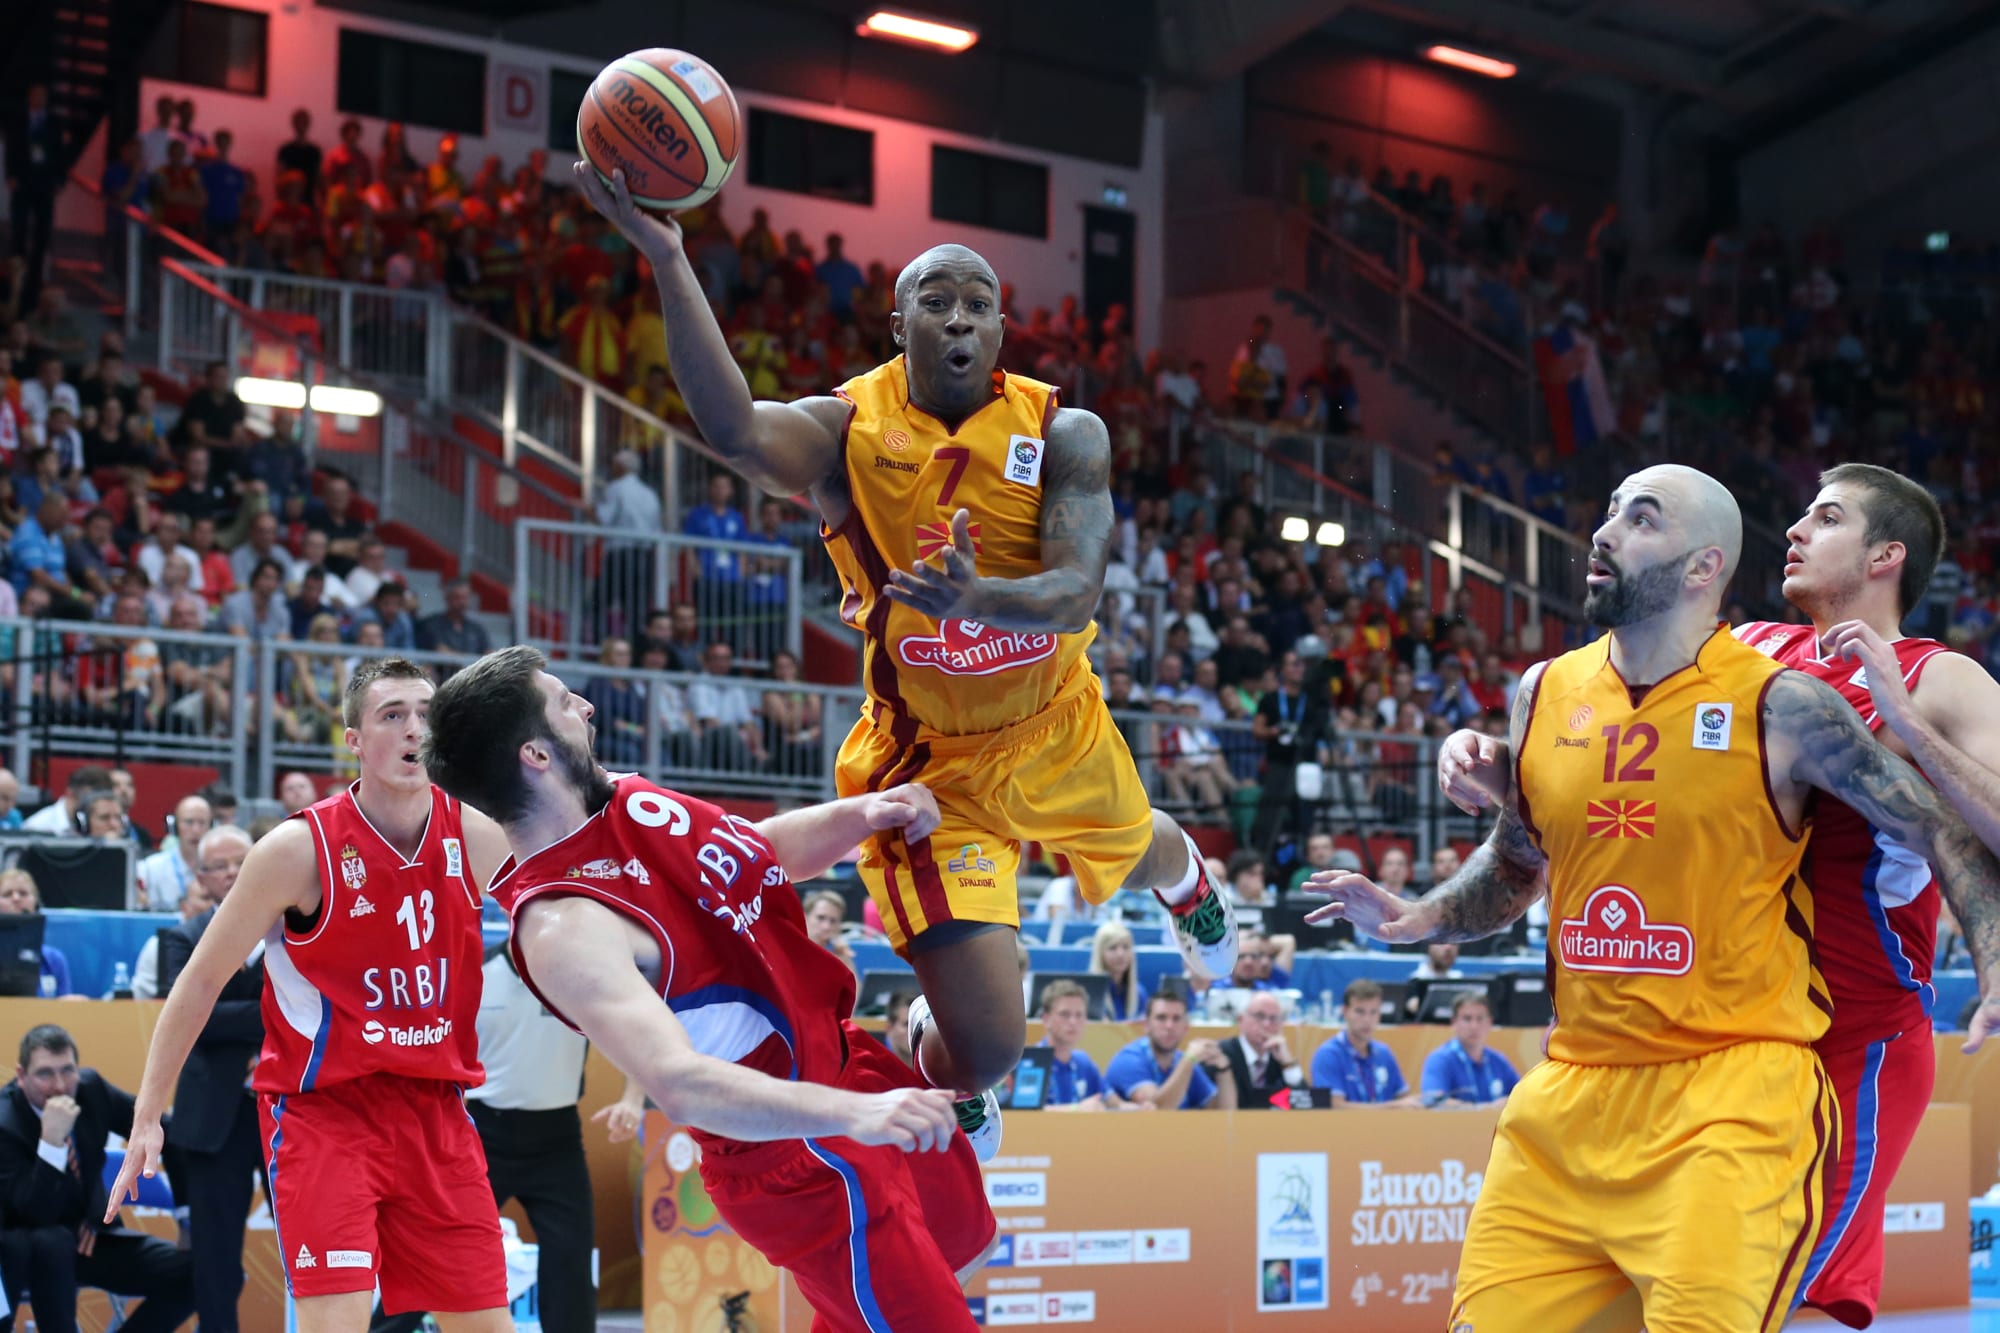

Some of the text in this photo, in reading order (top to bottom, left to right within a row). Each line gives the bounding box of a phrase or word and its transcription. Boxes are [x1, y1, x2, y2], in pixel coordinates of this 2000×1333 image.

[506, 77, 534, 119] D
[609, 78, 690, 161] molten
[612, 104, 658, 152] OFFICIAL
[874, 455, 920, 475] SPALDING
[934, 447, 970, 506] 7
[1013, 463, 1032, 477] FIBA
[916, 632, 1048, 669] vitaminka
[1554, 736, 1590, 749] SPALDING
[1601, 722, 1660, 783] 12
[1702, 731, 1721, 741] FIBA
[626, 791, 691, 837] 9
[349, 903, 377, 919] PEAK
[396, 889, 435, 951] 13
[1563, 930, 1681, 962] vitaminka
[991, 1183, 1039, 1197] BEKO
[295, 1256, 317, 1269] PEAK
